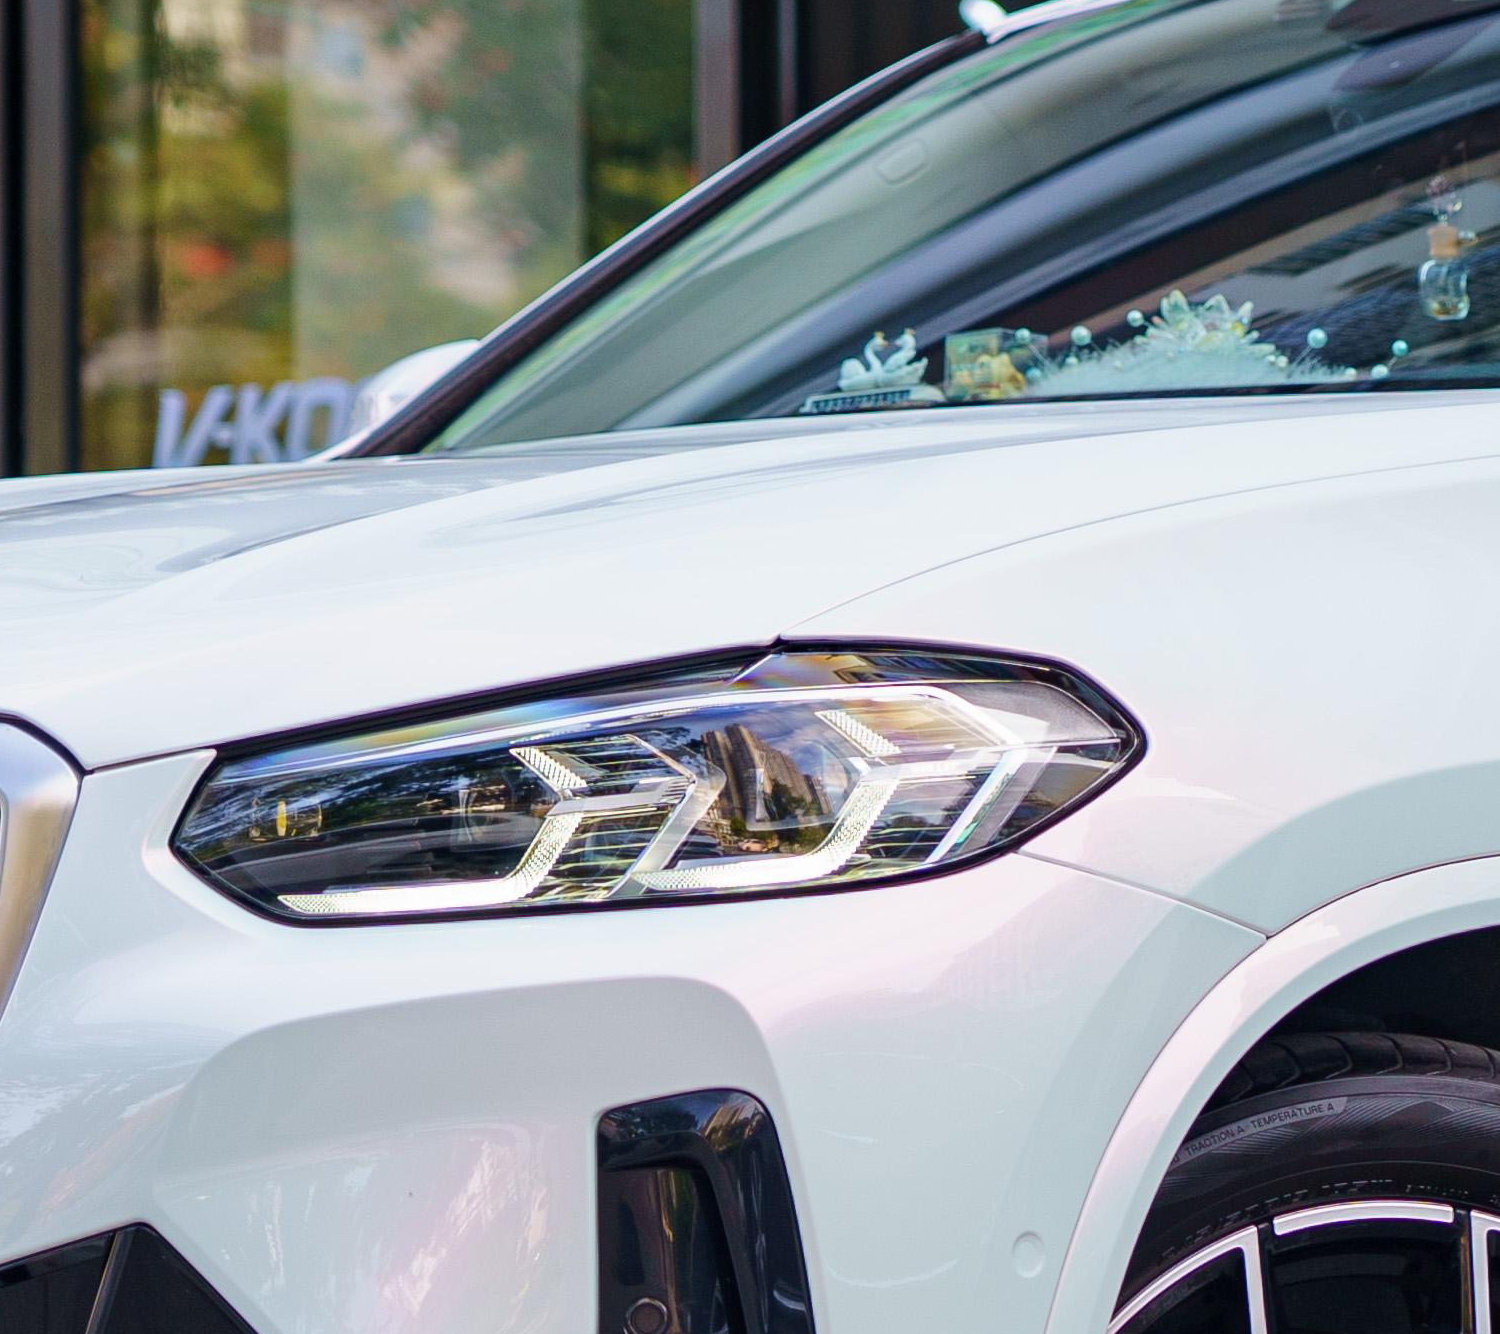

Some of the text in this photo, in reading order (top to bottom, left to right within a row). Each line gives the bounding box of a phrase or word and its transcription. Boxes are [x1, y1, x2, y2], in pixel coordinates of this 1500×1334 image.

[152, 375, 372, 467] V-KO
[1185, 1128, 1234, 1157] TRACTION
[1251, 1104, 1324, 1129] TEMPERATURE
